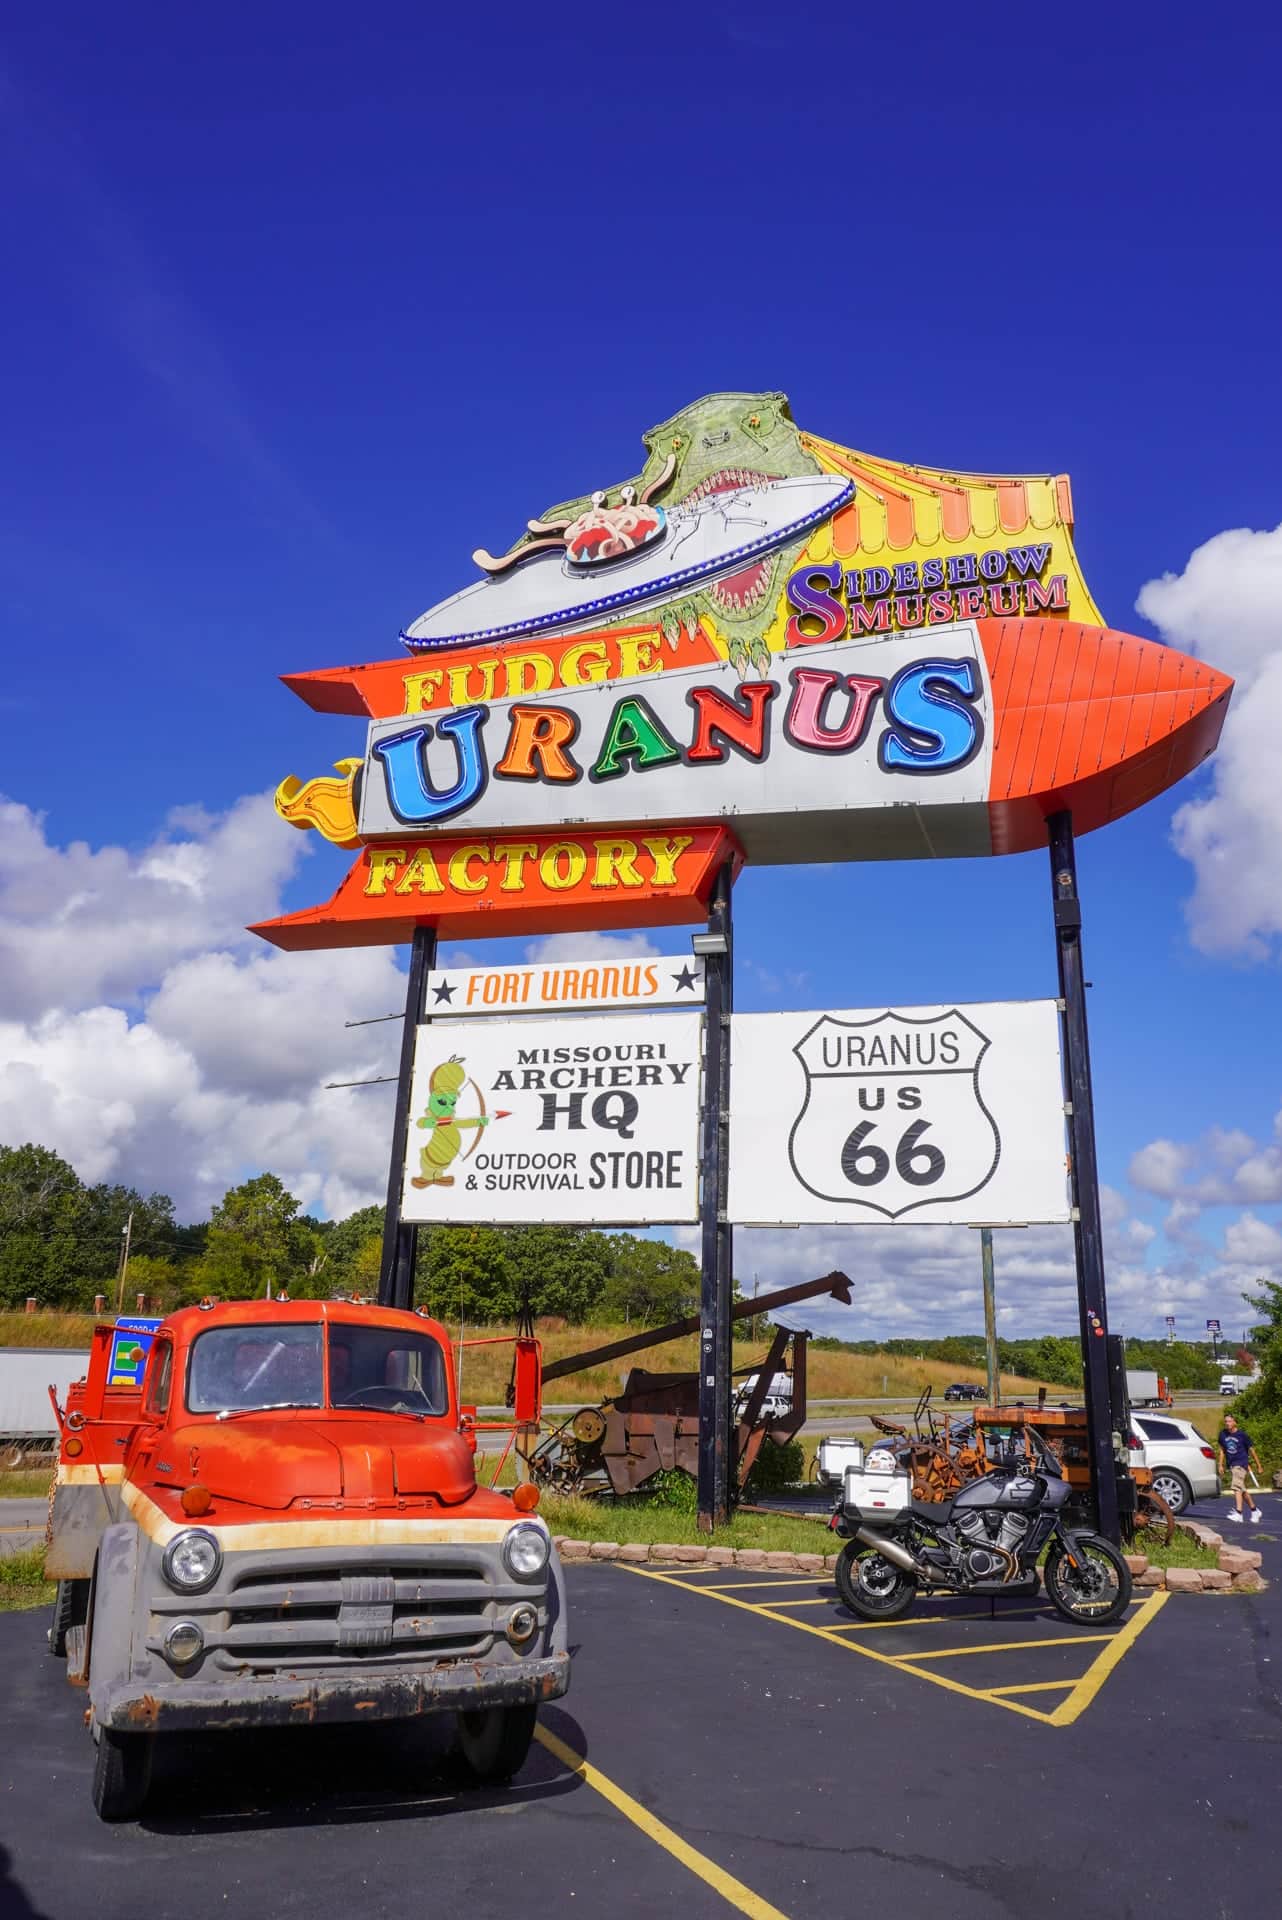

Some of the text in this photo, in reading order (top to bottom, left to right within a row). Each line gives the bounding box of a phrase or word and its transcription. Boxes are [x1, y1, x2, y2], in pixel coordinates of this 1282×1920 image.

[785, 543, 1052, 648] SIDESHOW
[851, 575, 1069, 634] MUSEUM
[402, 632, 664, 715] FUDGE
[373, 656, 983, 825] URANUS
[363, 835, 694, 897] FACTORY
[466, 964, 658, 1005] FORT URANUS
[517, 1043, 666, 1064] MISSOURI
[822, 1031, 960, 1068] URANUS
[490, 1063, 692, 1091] ARCHERY
[536, 1090, 638, 1139] HQ
[858, 1086, 922, 1111] US
[475, 1152, 576, 1170] OUTDOOR
[589, 1150, 683, 1189] STORE
[840, 1118, 946, 1187] 66
[465, 1174, 584, 1190] & SURVIVAL
